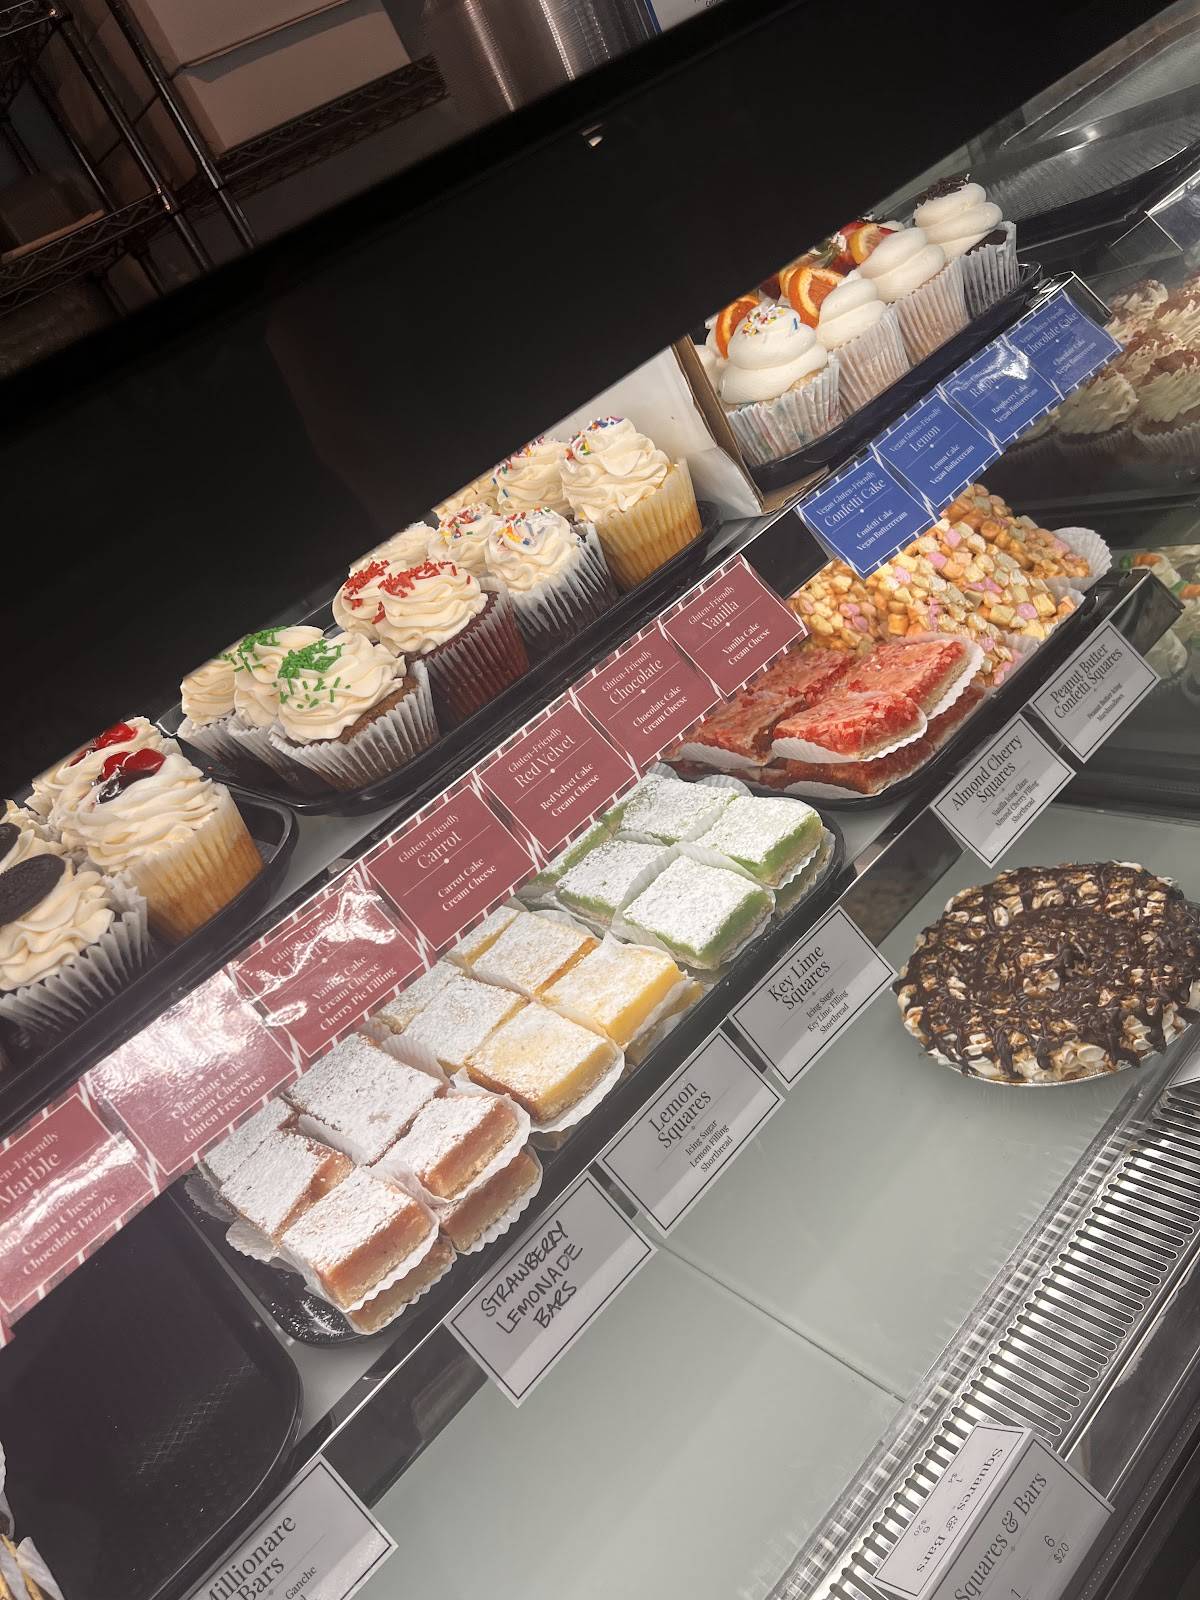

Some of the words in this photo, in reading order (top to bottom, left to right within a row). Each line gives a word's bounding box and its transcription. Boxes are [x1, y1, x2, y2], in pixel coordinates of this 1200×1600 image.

[1023, 326, 1061, 356] Chocolate
[1059, 312, 1079, 327] Cake
[991, 391, 1016, 414] Raspberry
[1015, 384, 1028, 396] Cake
[995, 409, 1011, 423] Vegan
[1011, 388, 1038, 413] Buttercream
[889, 438, 906, 452] Vegan
[904, 407, 941, 439] Gluten-Friendly
[909, 425, 940, 452] Lemon
[929, 455, 948, 471] Lemon
[946, 444, 960, 457] Cake
[929, 469, 948, 484] Vegan
[944, 445, 975, 471] Buttercream
[816, 503, 835, 517] Vegan
[833, 471, 875, 504] Gluten-Friendly
[824, 495, 864, 527] Confetti
[861, 479, 887, 500] Cake
[856, 518, 880, 538] Confetti
[879, 510, 894, 523] Cake
[856, 537, 875, 551] Vegan
[873, 512, 908, 538] Buttercream
[688, 585, 735, 625] Gluten-Friendly
[702, 600, 740, 630] Vanilla
[722, 632, 745, 655] Vanilla
[743, 622, 760, 637] Cake
[728, 646, 750, 666] Cream
[748, 628, 770, 649] Cheese
[601, 650, 652, 692] Gluten-Friendly
[609, 660, 664, 705] Chocolate
[1049, 669, 1083, 704] Peanut
[1078, 643, 1109, 674] Butter
[1054, 683, 1091, 719] Confetti
[1087, 648, 1123, 685] Squares
[633, 698, 665, 727] Chocolate
[663, 685, 682, 701] Cake
[642, 713, 666, 735] Cream
[663, 696, 688, 717] Cheese
[508, 727, 562, 773] Gluten-Friendly
[514, 761, 542, 789] Red
[537, 735, 576, 767] Velvet
[540, 793, 556, 811] Red
[553, 777, 576, 799] Velvet
[574, 762, 594, 781] Cake
[551, 794, 577, 817] Cream
[574, 773, 600, 797] Cheese
[951, 766, 991, 811] Almond
[987, 735, 1023, 771] Cherry
[976, 762, 1016, 803] Squares
[1012, 797, 1036, 824] Shortbread
[399, 813, 460, 864] Gluten-Friendly
[417, 830, 462, 869] Carrot
[438, 872, 465, 898] Carrot
[463, 857, 485, 877] Cake
[442, 888, 470, 912] Cream
[468, 864, 497, 890] Cheese
[312, 973, 345, 1000] Vanilla
[343, 956, 368, 979] Cake
[318, 989, 350, 1015] Cream
[348, 963, 381, 991] Cheese
[767, 976, 796, 1003] Key
[790, 946, 825, 980] Lime
[782, 960, 831, 1011] Squares
[320, 1006, 353, 1032] Cherry
[351, 987, 368, 1006] Pie
[366, 967, 398, 993] Filling
[806, 1000, 823, 1019] Icing
[820, 987, 837, 1007] Sugar
[807, 1018, 820, 1033] Key
[818, 1004, 833, 1021] Lime
[830, 989, 849, 1012] Filling
[819, 1002, 850, 1035] Shortbread
[172, 1077, 222, 1120] Chocolate
[220, 1060, 247, 1080] Cake
[182, 1099, 218, 1128] Cream
[216, 1071, 251, 1101] Cheese
[183, 1114, 219, 1144] Gluten
[218, 1095, 242, 1117] Free
[240, 1075, 267, 1097] Oreo
[648, 1081, 699, 1134] Lemon
[657, 1090, 712, 1150] Squares
[684, 1136, 704, 1157] Icing
[699, 1119, 719, 1141] Sugar
[689, 1143, 712, 1169] Lemon
[708, 1124, 730, 1147] Filling
[700, 1136, 734, 1173] Shortbread
[22, 1223, 61, 1256] Cream
[59, 1189, 100, 1225] Cheese
[23, 1228, 80, 1276] Chocolate
[78, 1193, 118, 1230] Drizzle
[481, 1220, 569, 1318] STRAWBERRY
[496, 1243, 584, 1334] LEMONADE
[533, 1280, 578, 1329] BARS
[956, 1448, 1003, 1511] Squares
[913, 1519, 928, 1537] $20
[922, 1525, 931, 1535] 6
[945, 1515, 959, 1532] &
[953, 1533, 1009, 1600] Squares
[1001, 1510, 1019, 1534] &
[1012, 1472, 1048, 1517] Bars
[1043, 1534, 1056, 1548] 6
[916, 1535, 946, 1573] Bars
[1053, 1542, 1070, 1564] $20
[236, 1557, 285, 1600] Bars
[285, 1566, 317, 1600] Ganche
[1010, 1587, 1022, 1599] 1
